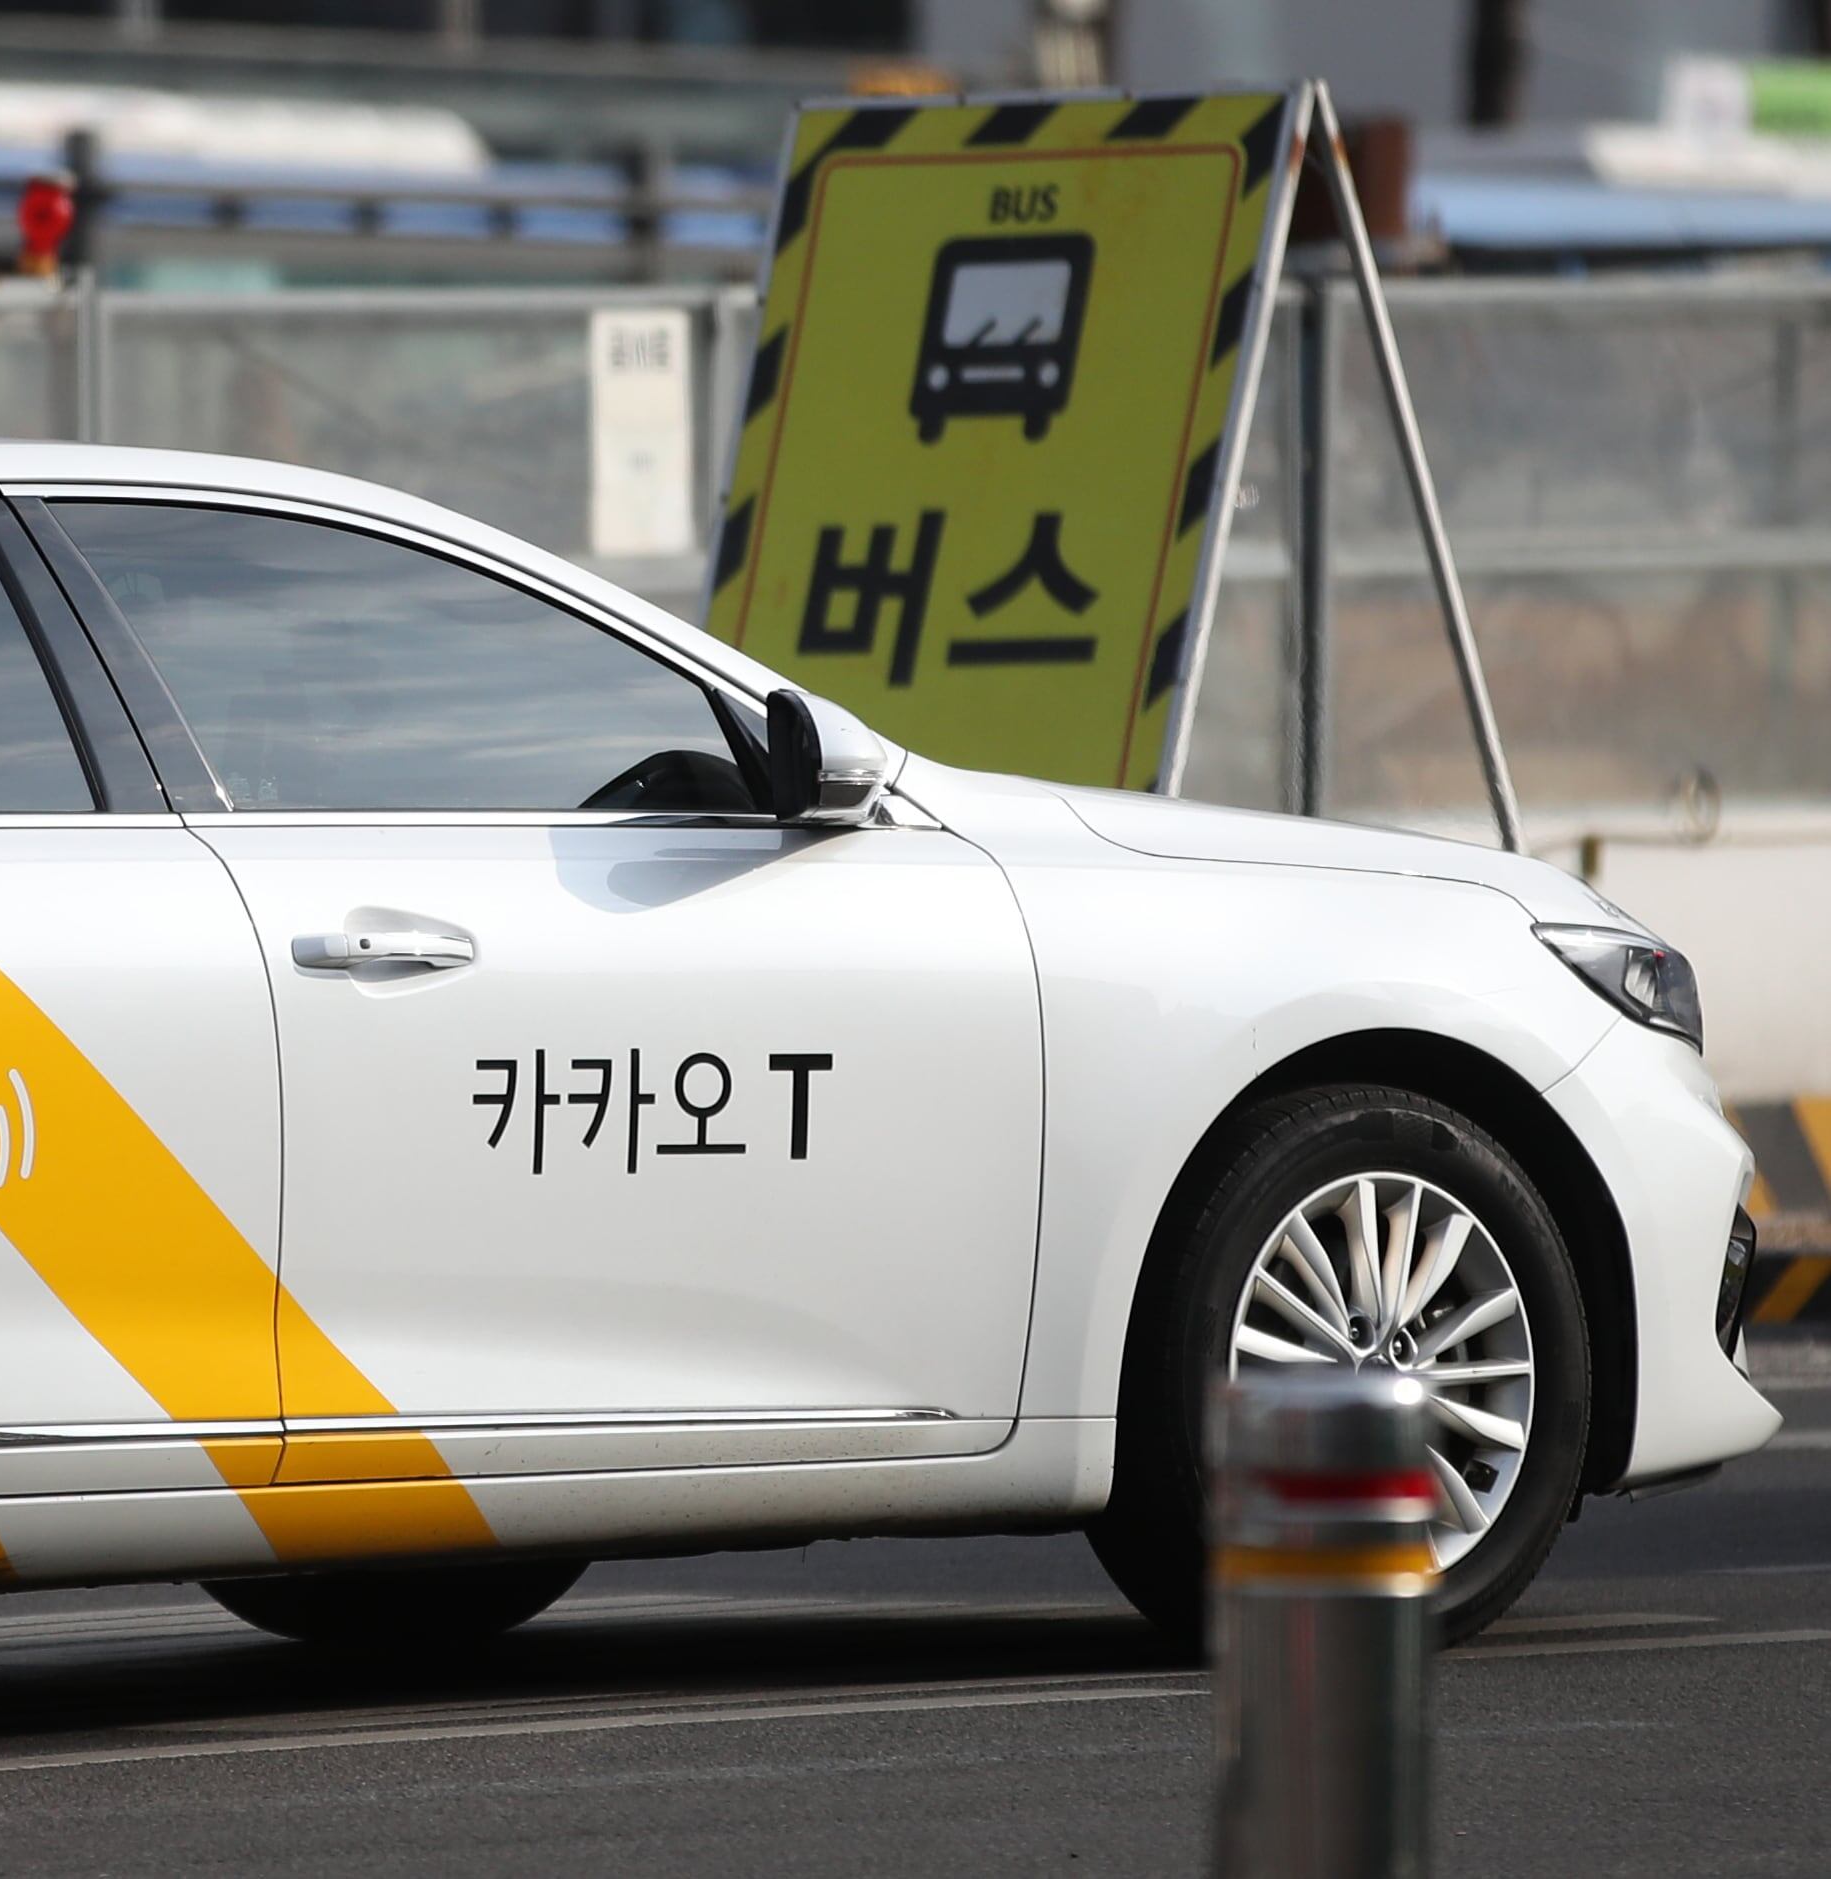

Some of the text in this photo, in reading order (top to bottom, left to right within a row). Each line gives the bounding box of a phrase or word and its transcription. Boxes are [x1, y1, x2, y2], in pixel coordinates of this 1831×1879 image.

[990, 184, 1060, 223] BUS
[797, 508, 1100, 688] 버스
[472, 1048, 833, 1175] 카카오 T
